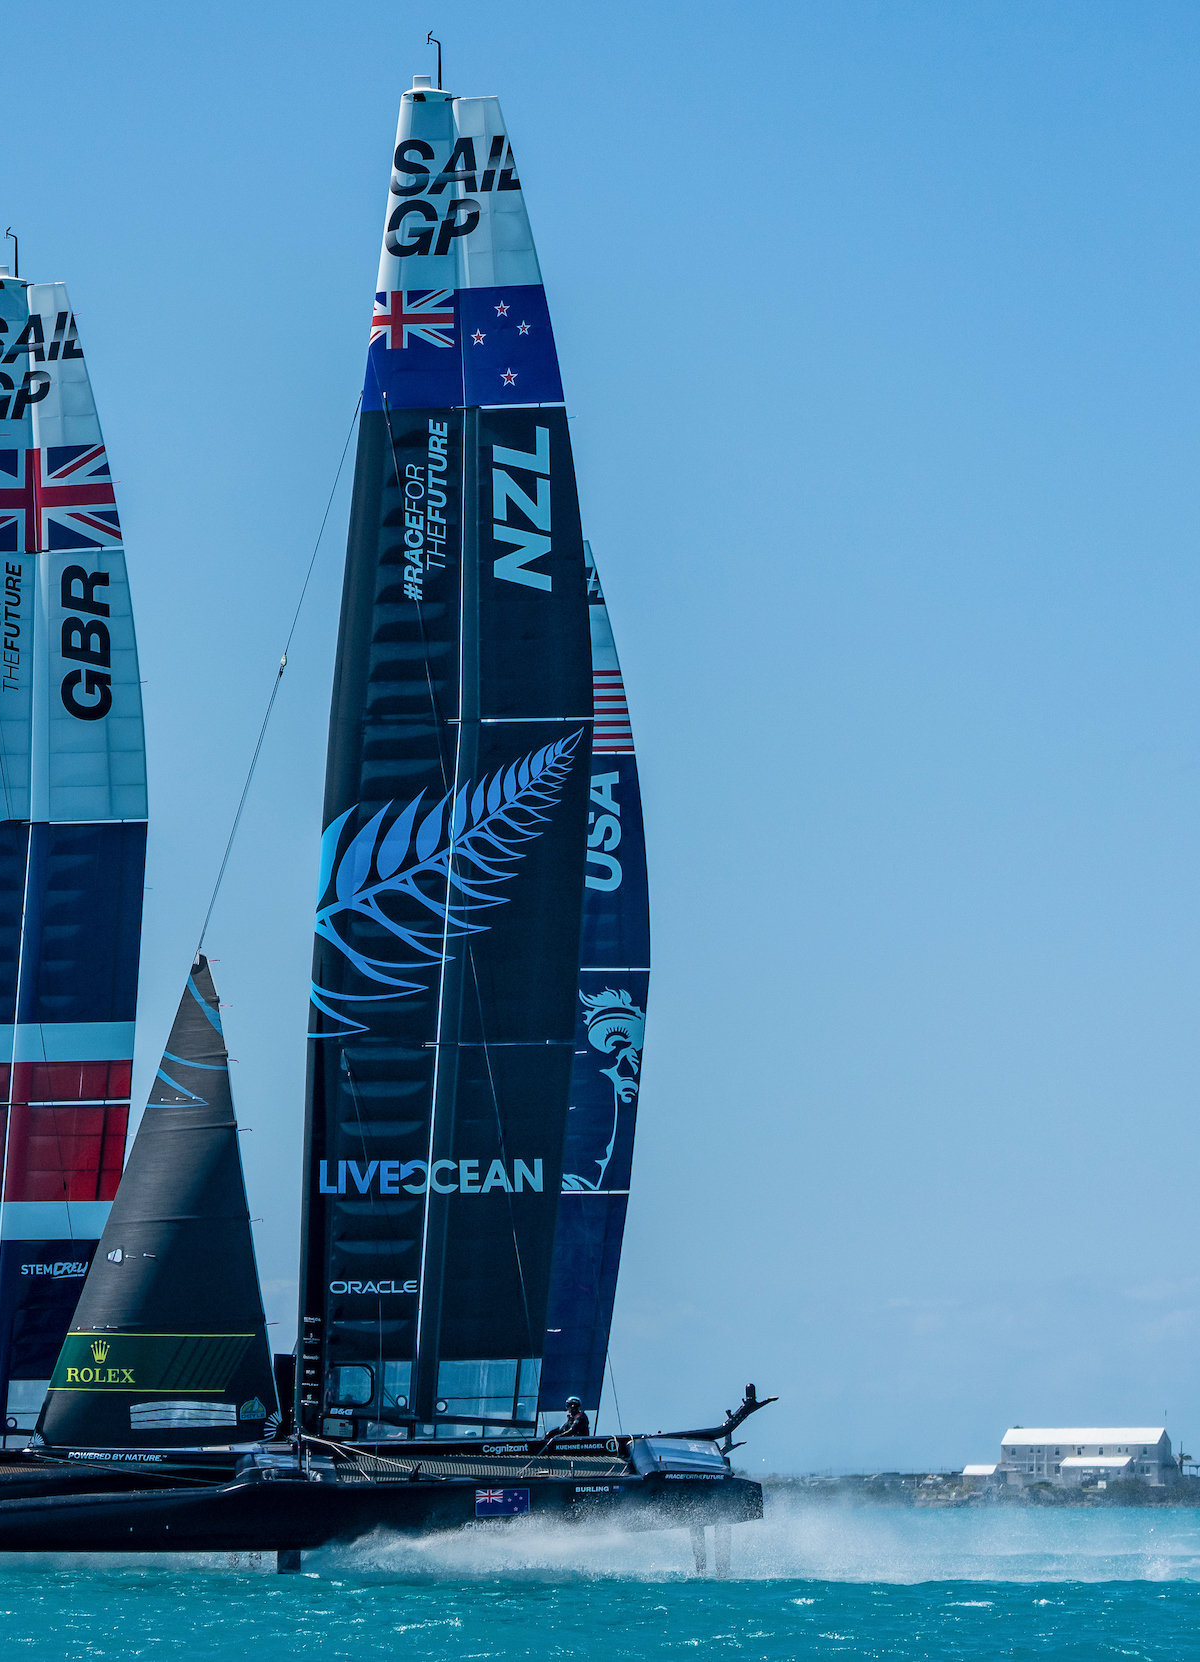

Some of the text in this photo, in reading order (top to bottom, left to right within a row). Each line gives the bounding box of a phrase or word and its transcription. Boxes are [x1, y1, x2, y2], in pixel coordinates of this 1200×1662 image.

[389, 135, 521, 196] SAIL
[385, 198, 482, 257] GP
[426, 418, 448, 571] THEFUTURE
[492, 425, 552, 592] NZL
[403, 463, 425, 601] #RACEFOR
[2, 561, 22, 692] THEFUTURE
[61, 564, 112, 721] GBR
[585, 771, 623, 892] USA
[329, 1280, 418, 1294] ORACLE
[66, 1367, 135, 1383] ROLEX
[330, 1407, 353, 1415] B&G
[67, 1452, 111, 1460] POWERED
[482, 1443, 528, 1454] Cognizant
